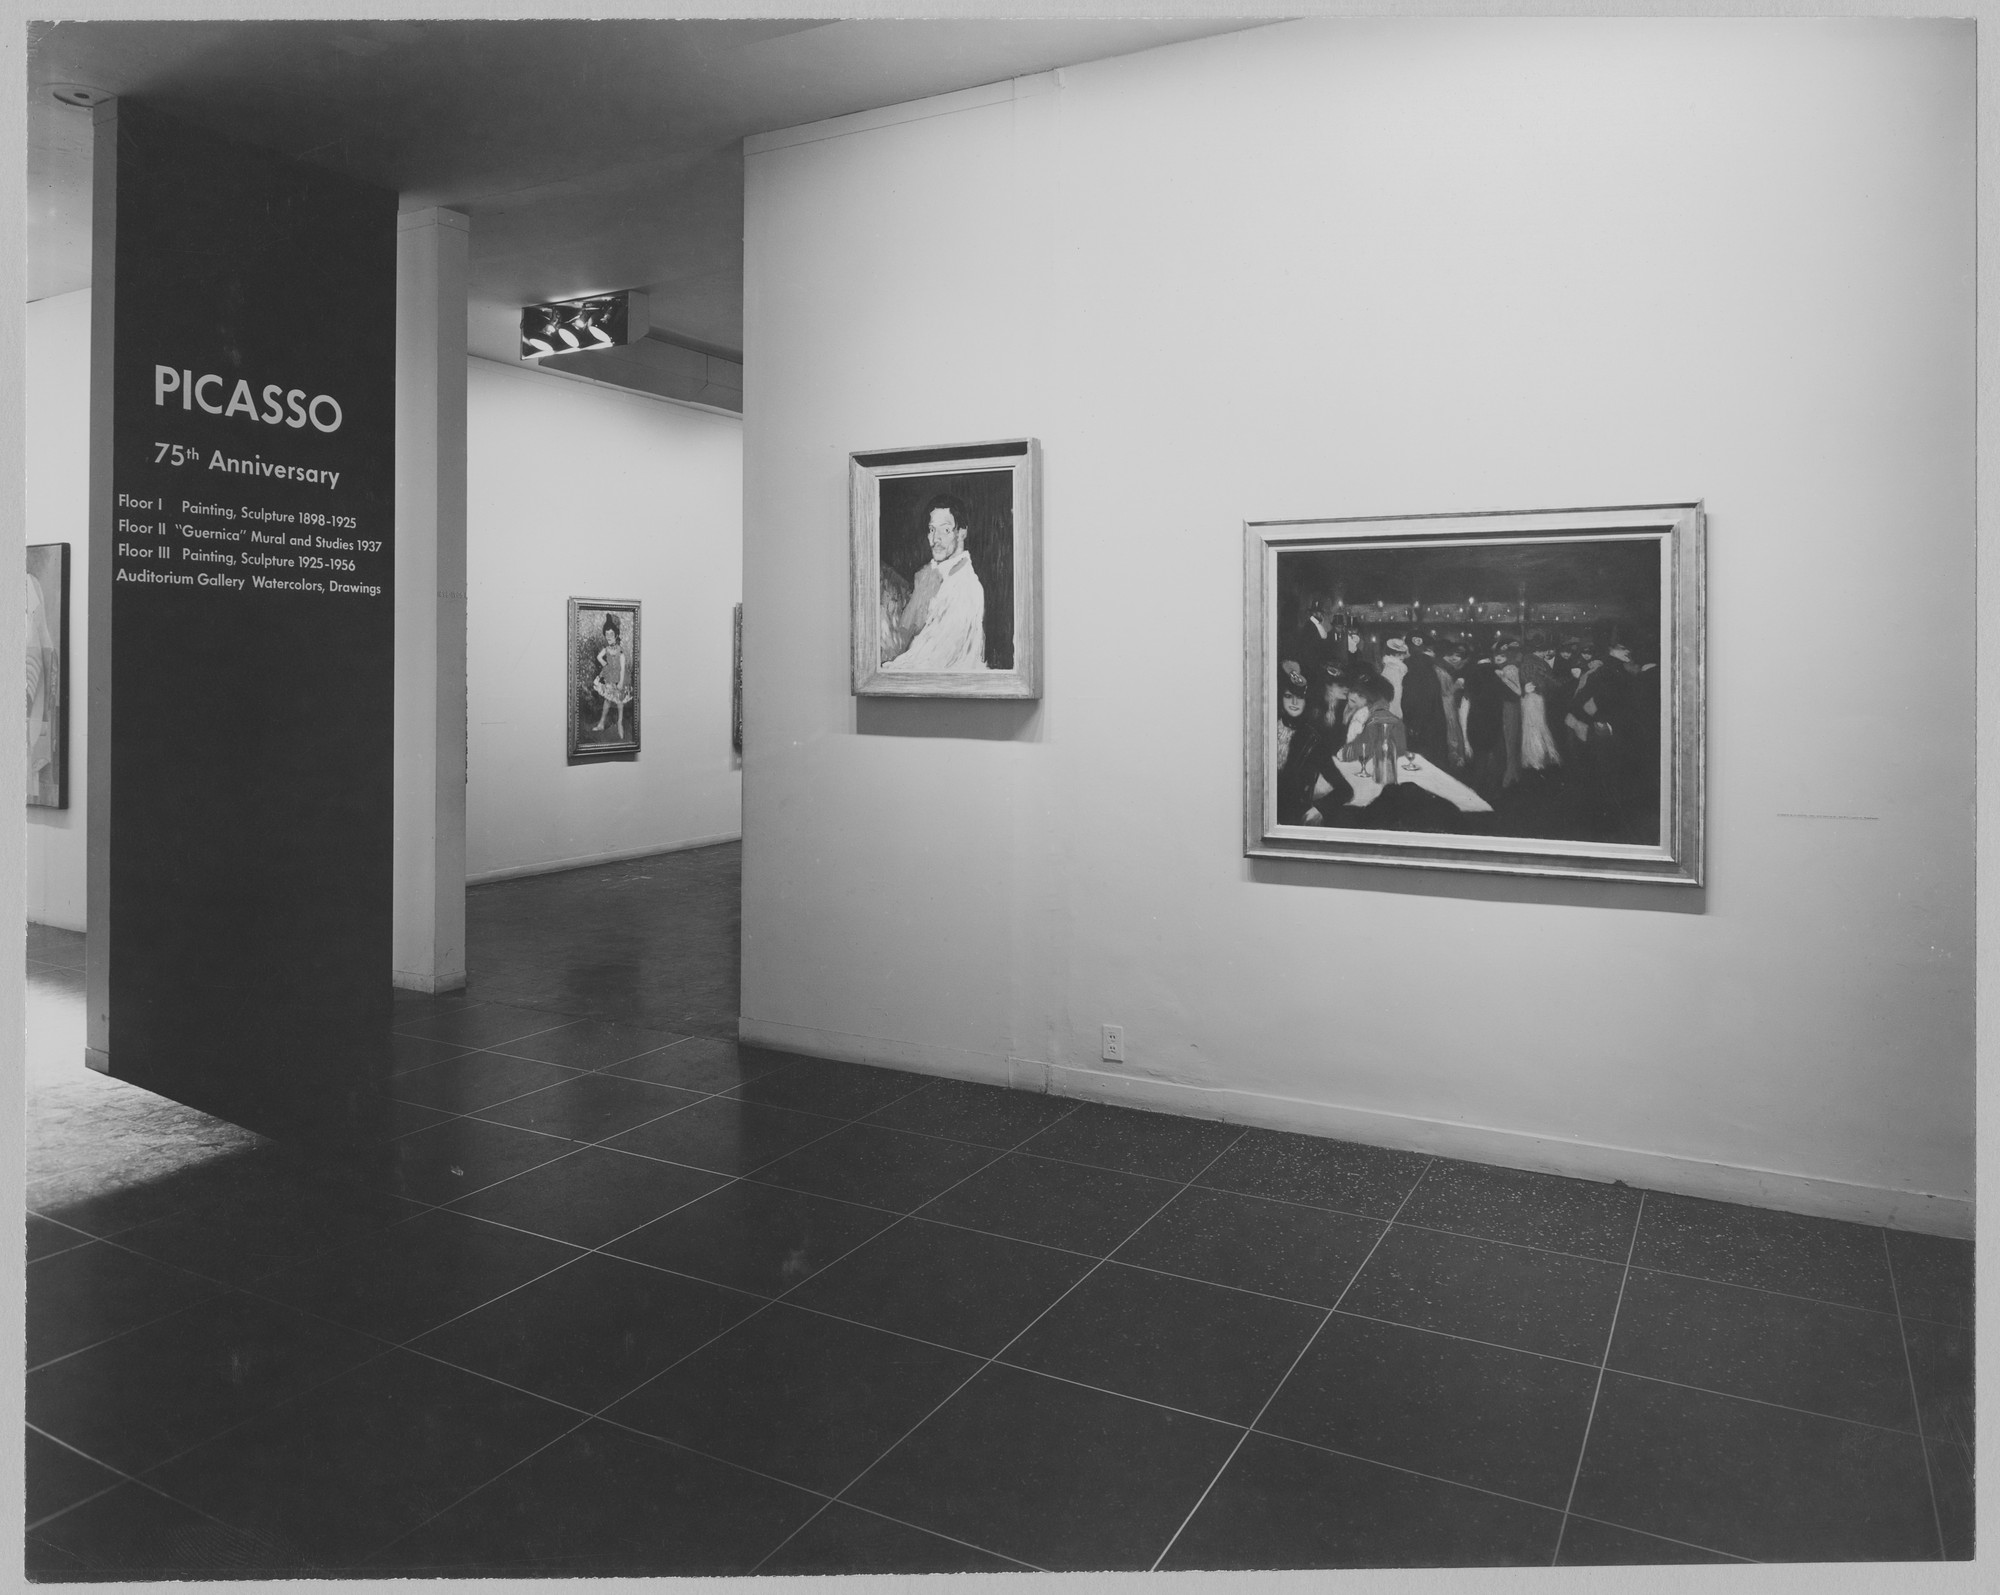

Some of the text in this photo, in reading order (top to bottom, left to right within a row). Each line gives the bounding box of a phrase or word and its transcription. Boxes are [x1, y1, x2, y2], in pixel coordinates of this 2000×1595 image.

[156, 365, 342, 432] PICASSO
[154, 441, 340, 489] 75th Anniversary
[119, 494, 153, 509] Floor
[182, 501, 237, 520] Painting,
[241, 507, 295, 523] Sculpture
[299, 511, 357, 528] 1898-1925
[119, 519, 153, 534] Floor
[158, 523, 166, 535] II
[251, 530, 285, 545] Mural
[289, 534, 312, 547] and
[315, 535, 354, 551] Studies
[357, 540, 382, 553] 1937
[118, 543, 356, 571] Floor III Painting, Sculpture 1925-1956
[116, 568, 382, 597] Auditorium Gallery Watercolors, Drawings
